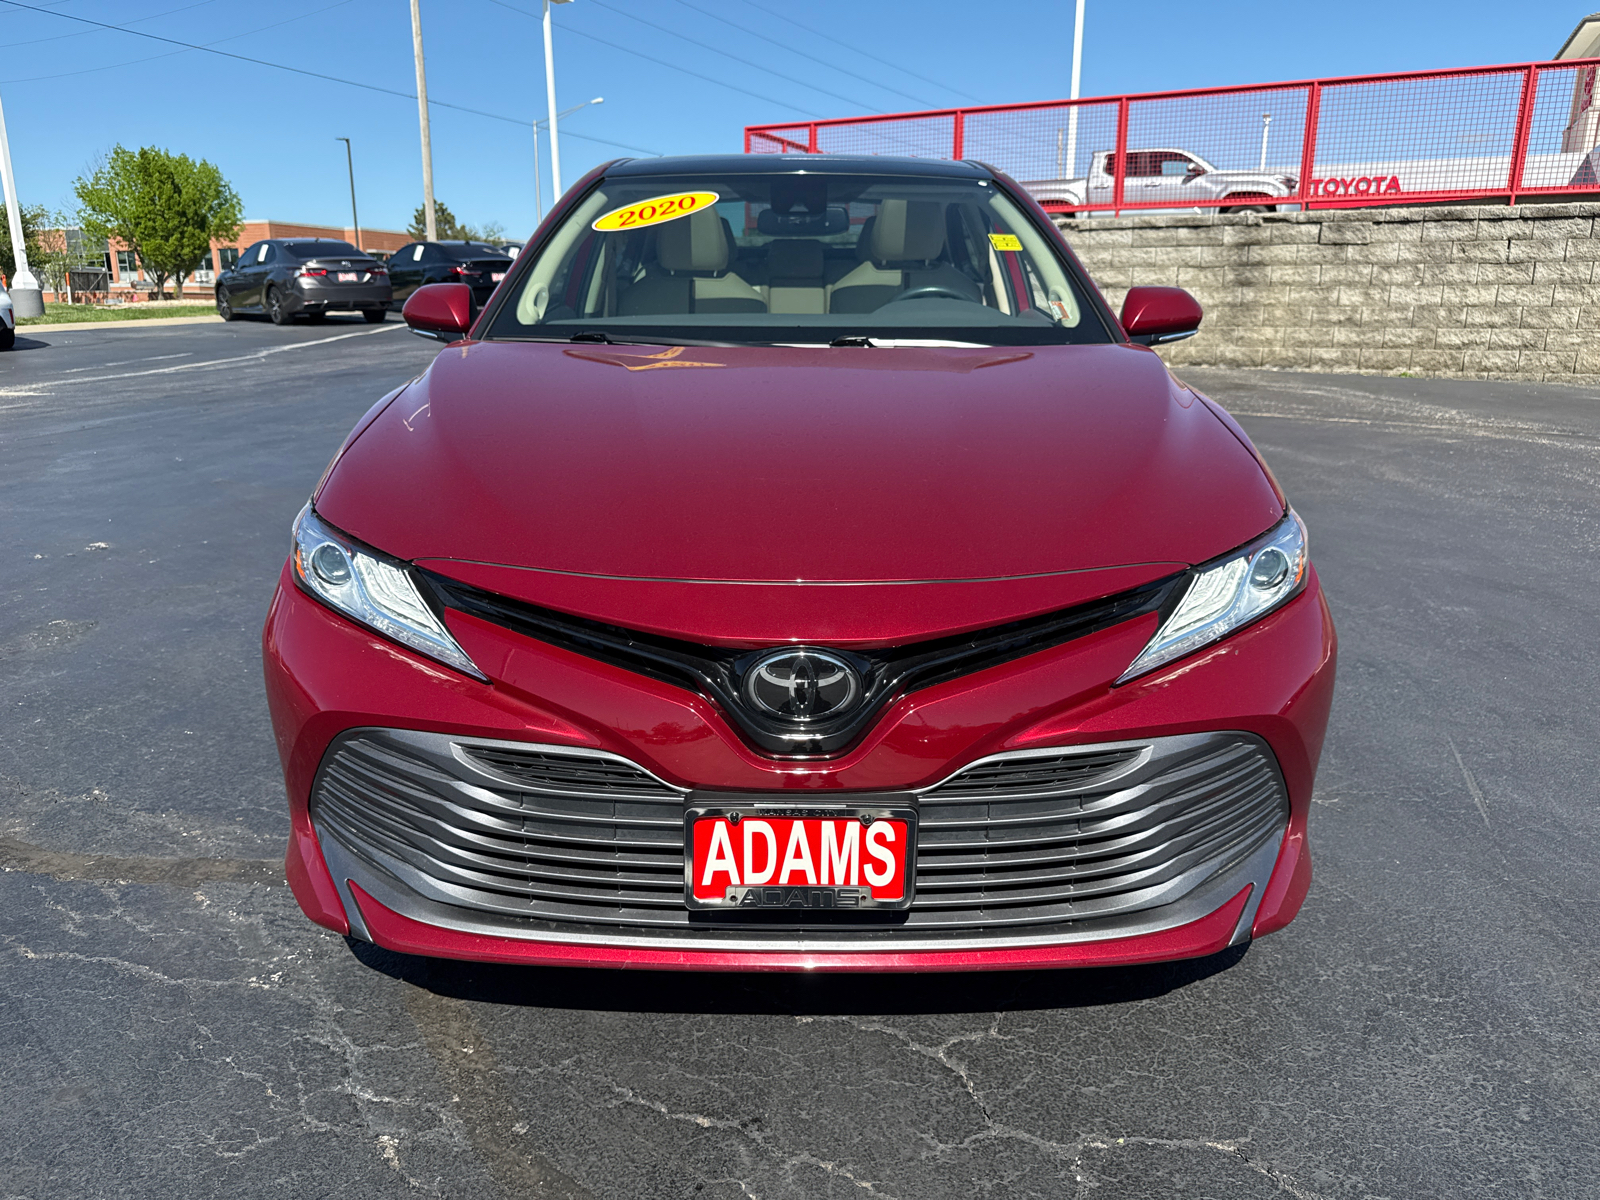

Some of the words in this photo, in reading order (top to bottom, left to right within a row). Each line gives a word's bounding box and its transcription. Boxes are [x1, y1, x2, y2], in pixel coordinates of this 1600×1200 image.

[1310, 175, 1401, 195] TOYOTA
[618, 196, 696, 228] 2020
[701, 820, 896, 887] ADAMS
[736, 888, 860, 908] ADAMS
